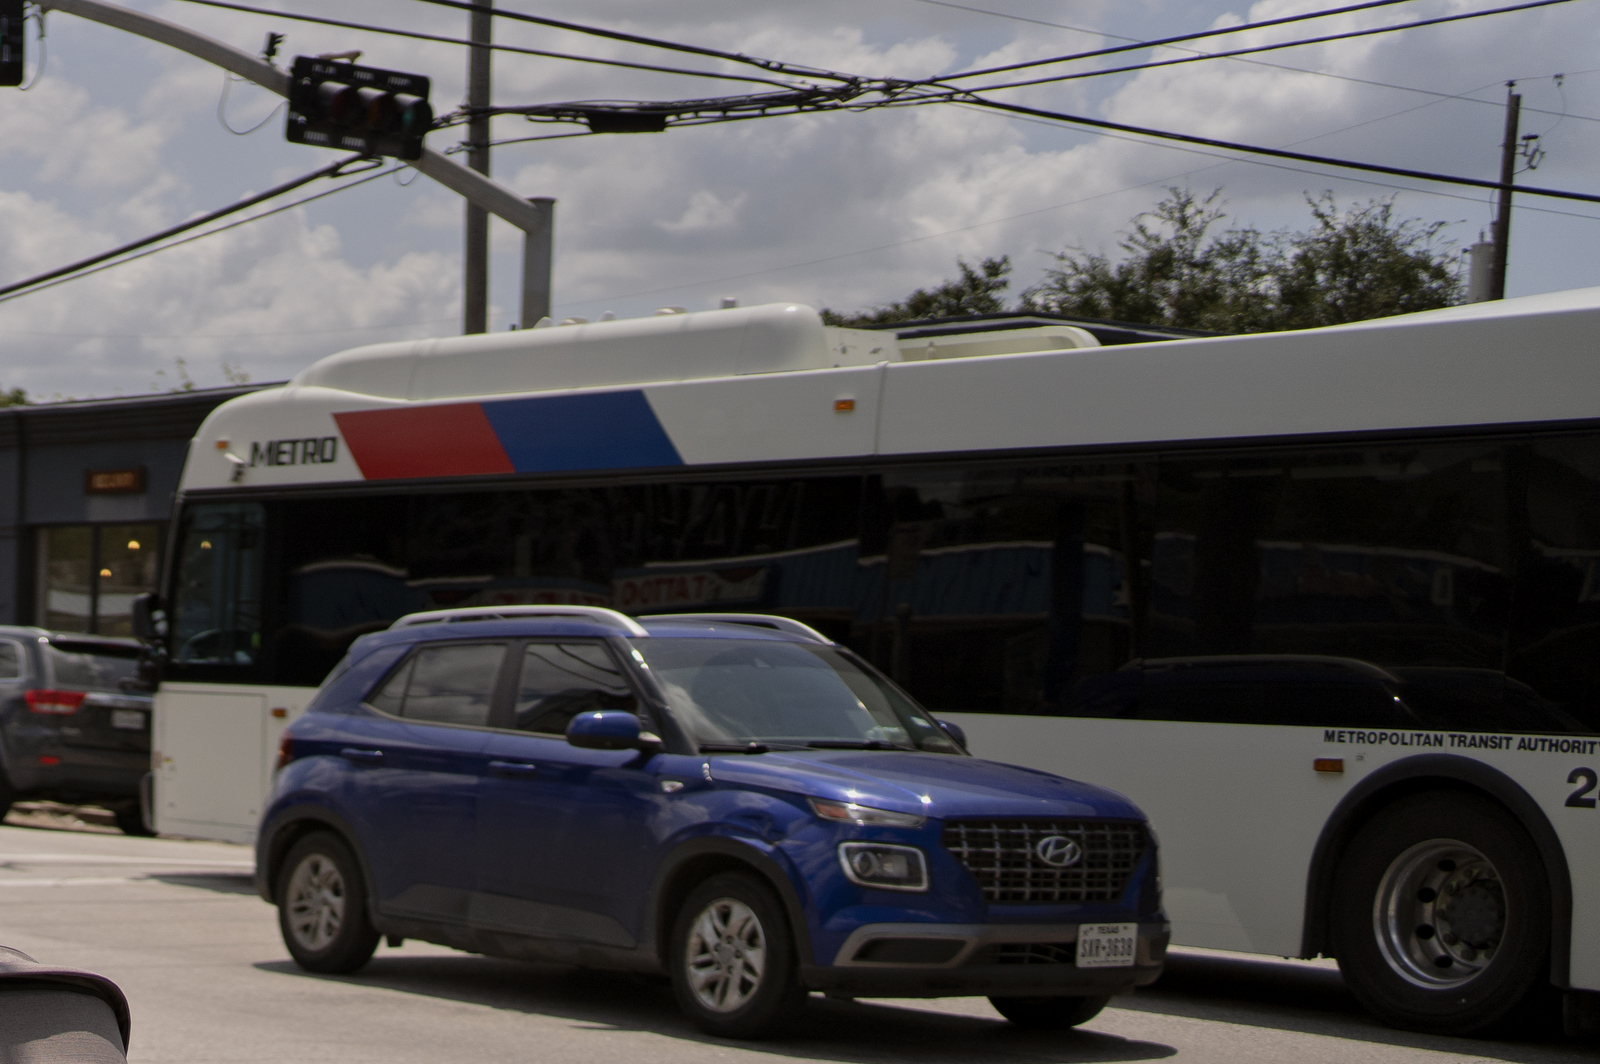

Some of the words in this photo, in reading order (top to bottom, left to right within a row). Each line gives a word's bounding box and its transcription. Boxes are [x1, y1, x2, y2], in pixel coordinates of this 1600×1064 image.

[249, 436, 338, 468] METRO
[1323, 729, 1444, 747] METROPOLITAN
[1448, 733, 1513, 750] TRANSIT
[1564, 766, 1600, 809] 2
